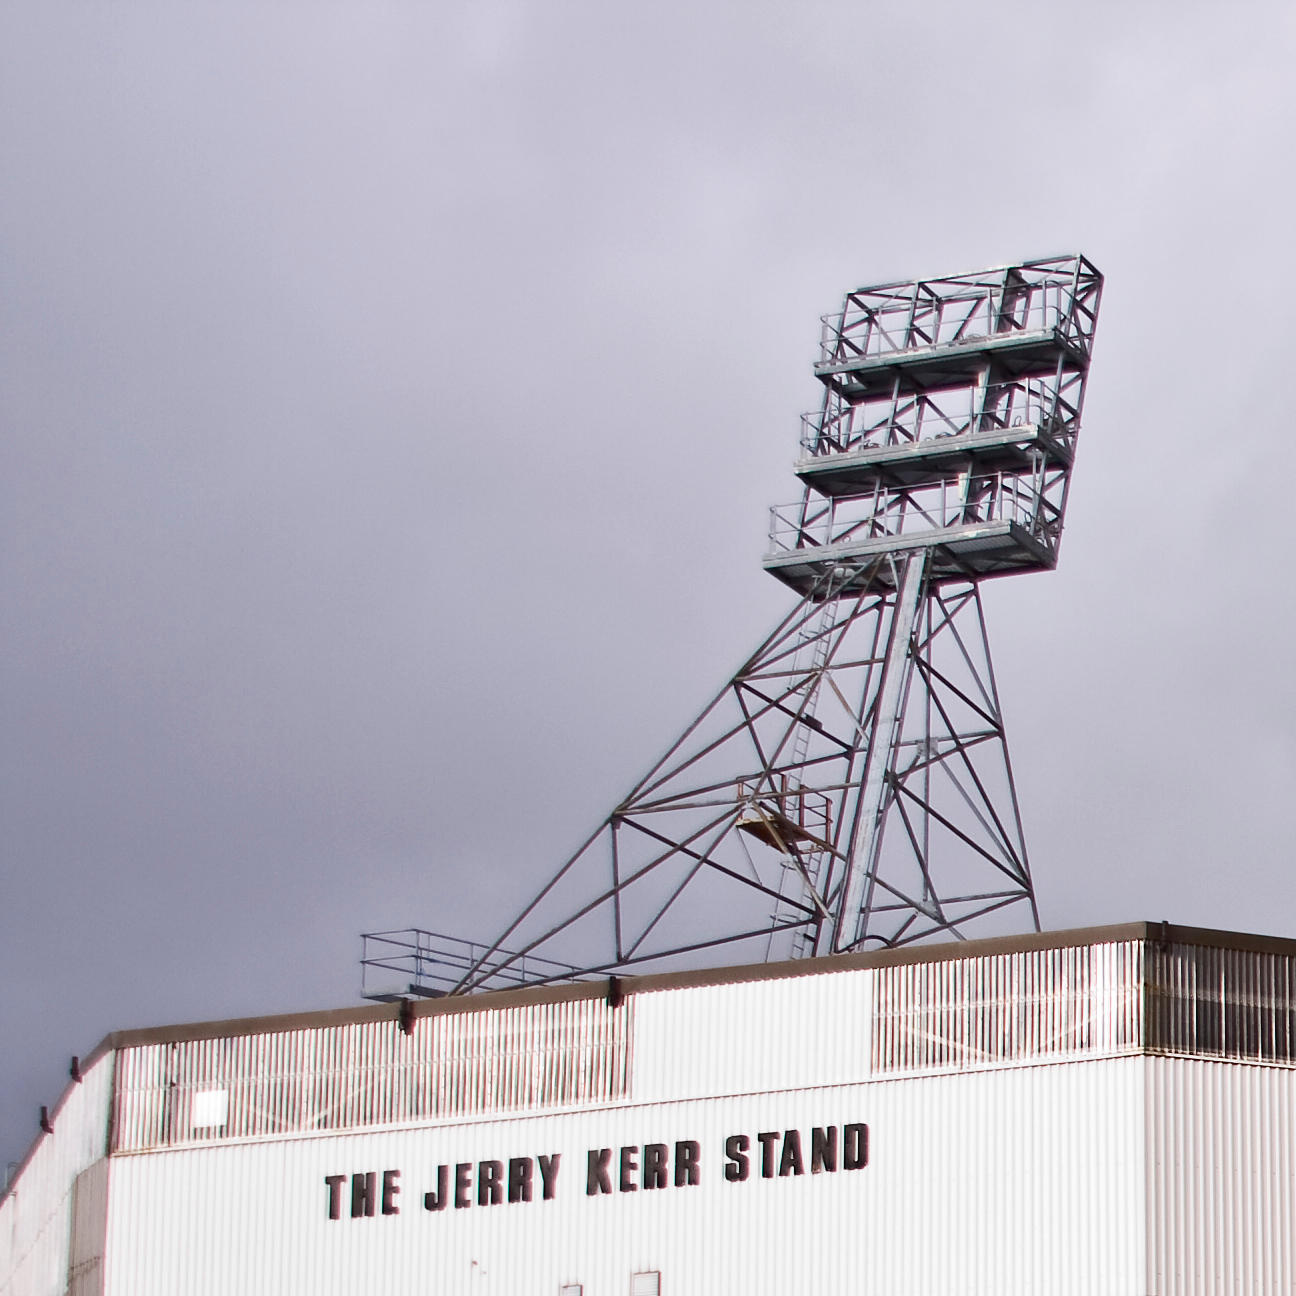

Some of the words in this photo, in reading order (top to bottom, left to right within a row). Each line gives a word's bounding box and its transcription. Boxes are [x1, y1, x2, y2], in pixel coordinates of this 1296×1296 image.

[324, 1169, 401, 1221] THE
[423, 1152, 561, 1212] JERRY
[585, 1139, 701, 1197] KERR
[723, 1122, 870, 1183] STAND
